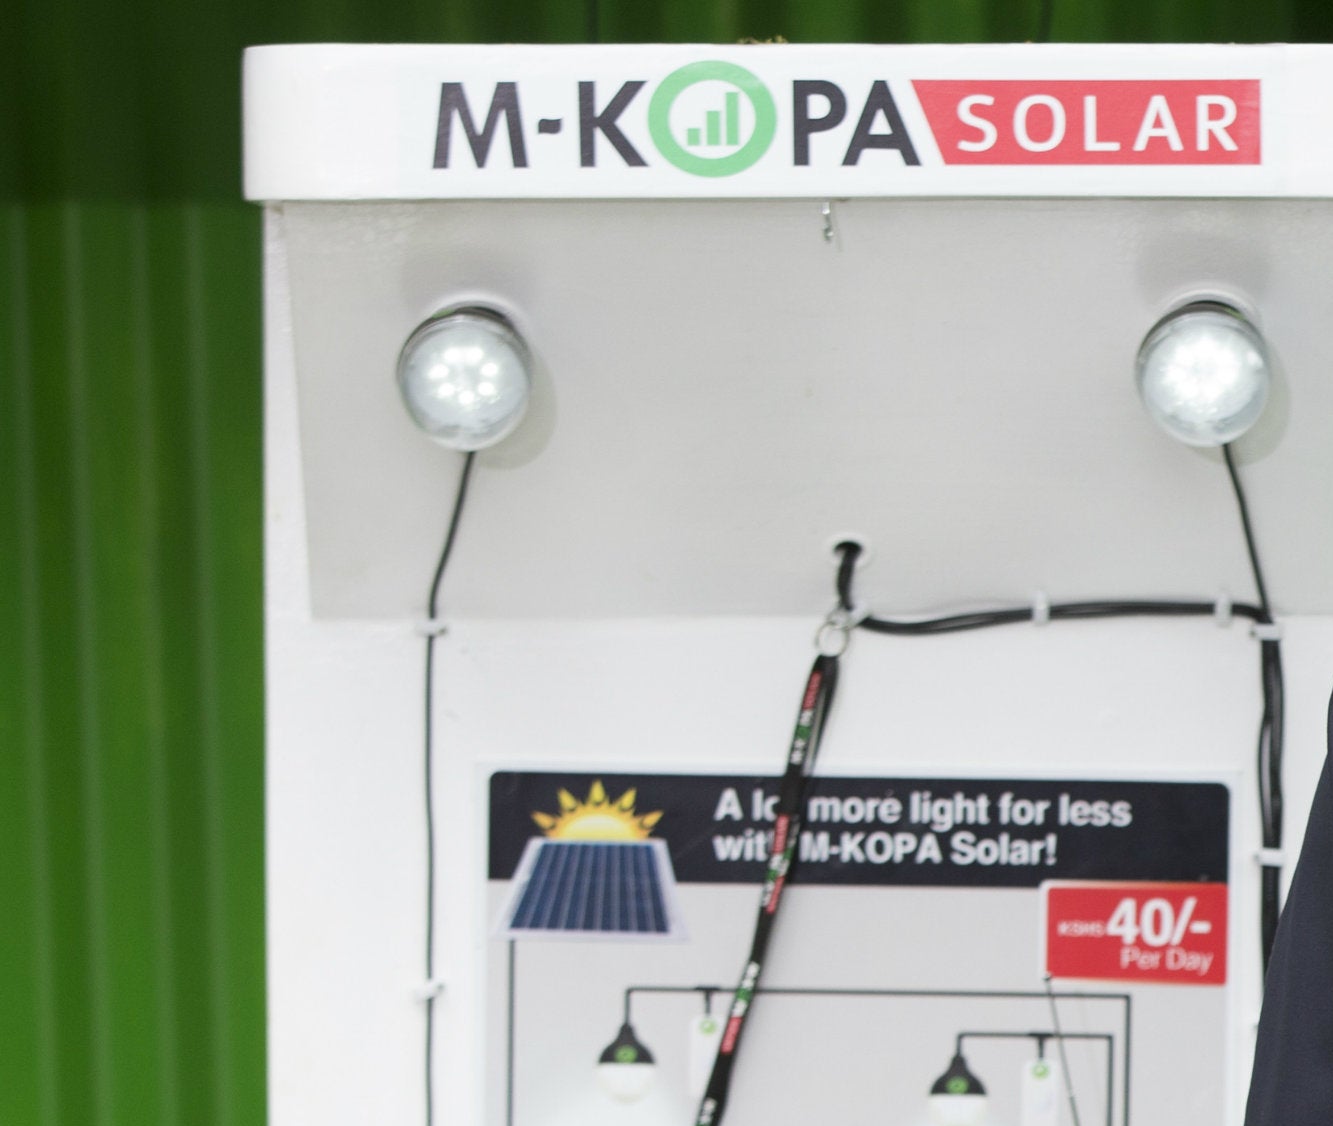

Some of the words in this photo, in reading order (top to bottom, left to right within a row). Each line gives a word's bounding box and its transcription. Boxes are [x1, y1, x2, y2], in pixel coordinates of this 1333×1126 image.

[431, 60, 922, 177] M-KOPA
[955, 93, 1241, 153] SOLAR
[713, 787, 744, 821] A
[752, 788, 780, 821] lo
[806, 794, 904, 824] more
[909, 790, 992, 832] light
[998, 791, 1051, 826] for
[1058, 792, 1134, 827] less
[800, 831, 943, 865] M-KOPA
[950, 830, 1058, 866] Solar!
[1105, 896, 1212, 947] 40/-
[1120, 945, 1162, 970] Per
[1165, 946, 1214, 977] Day
